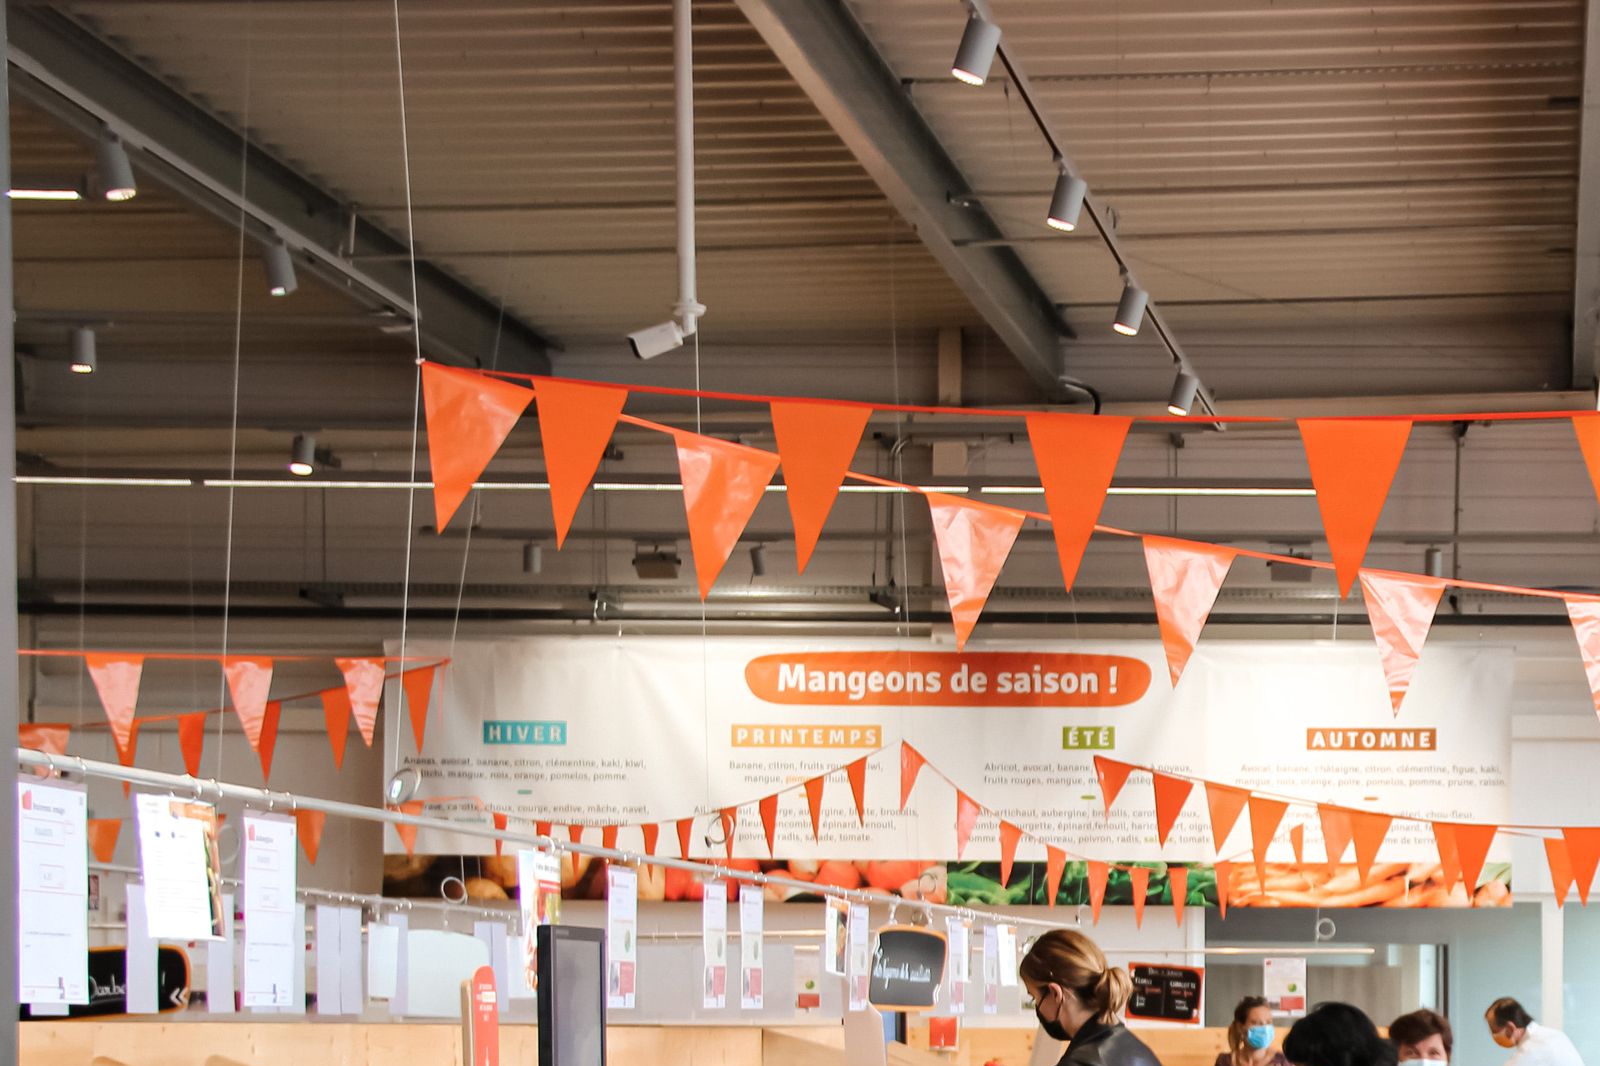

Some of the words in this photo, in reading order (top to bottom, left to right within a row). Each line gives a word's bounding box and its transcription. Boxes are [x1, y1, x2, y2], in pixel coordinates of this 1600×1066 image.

[777, 663, 942, 700] Mangeons
[950, 663, 986, 694] de
[997, 666, 1099, 694] saison
[1109, 666, 1118, 694] !
[488, 725, 562, 742] HIVER
[736, 728, 877, 745] PRINTEMPS
[1068, 726, 1110, 747] ÉTÉ
[1312, 731, 1431, 748] AUTOMNE
[514, 757, 543, 767] citron,
[545, 757, 599, 767] clémentine,
